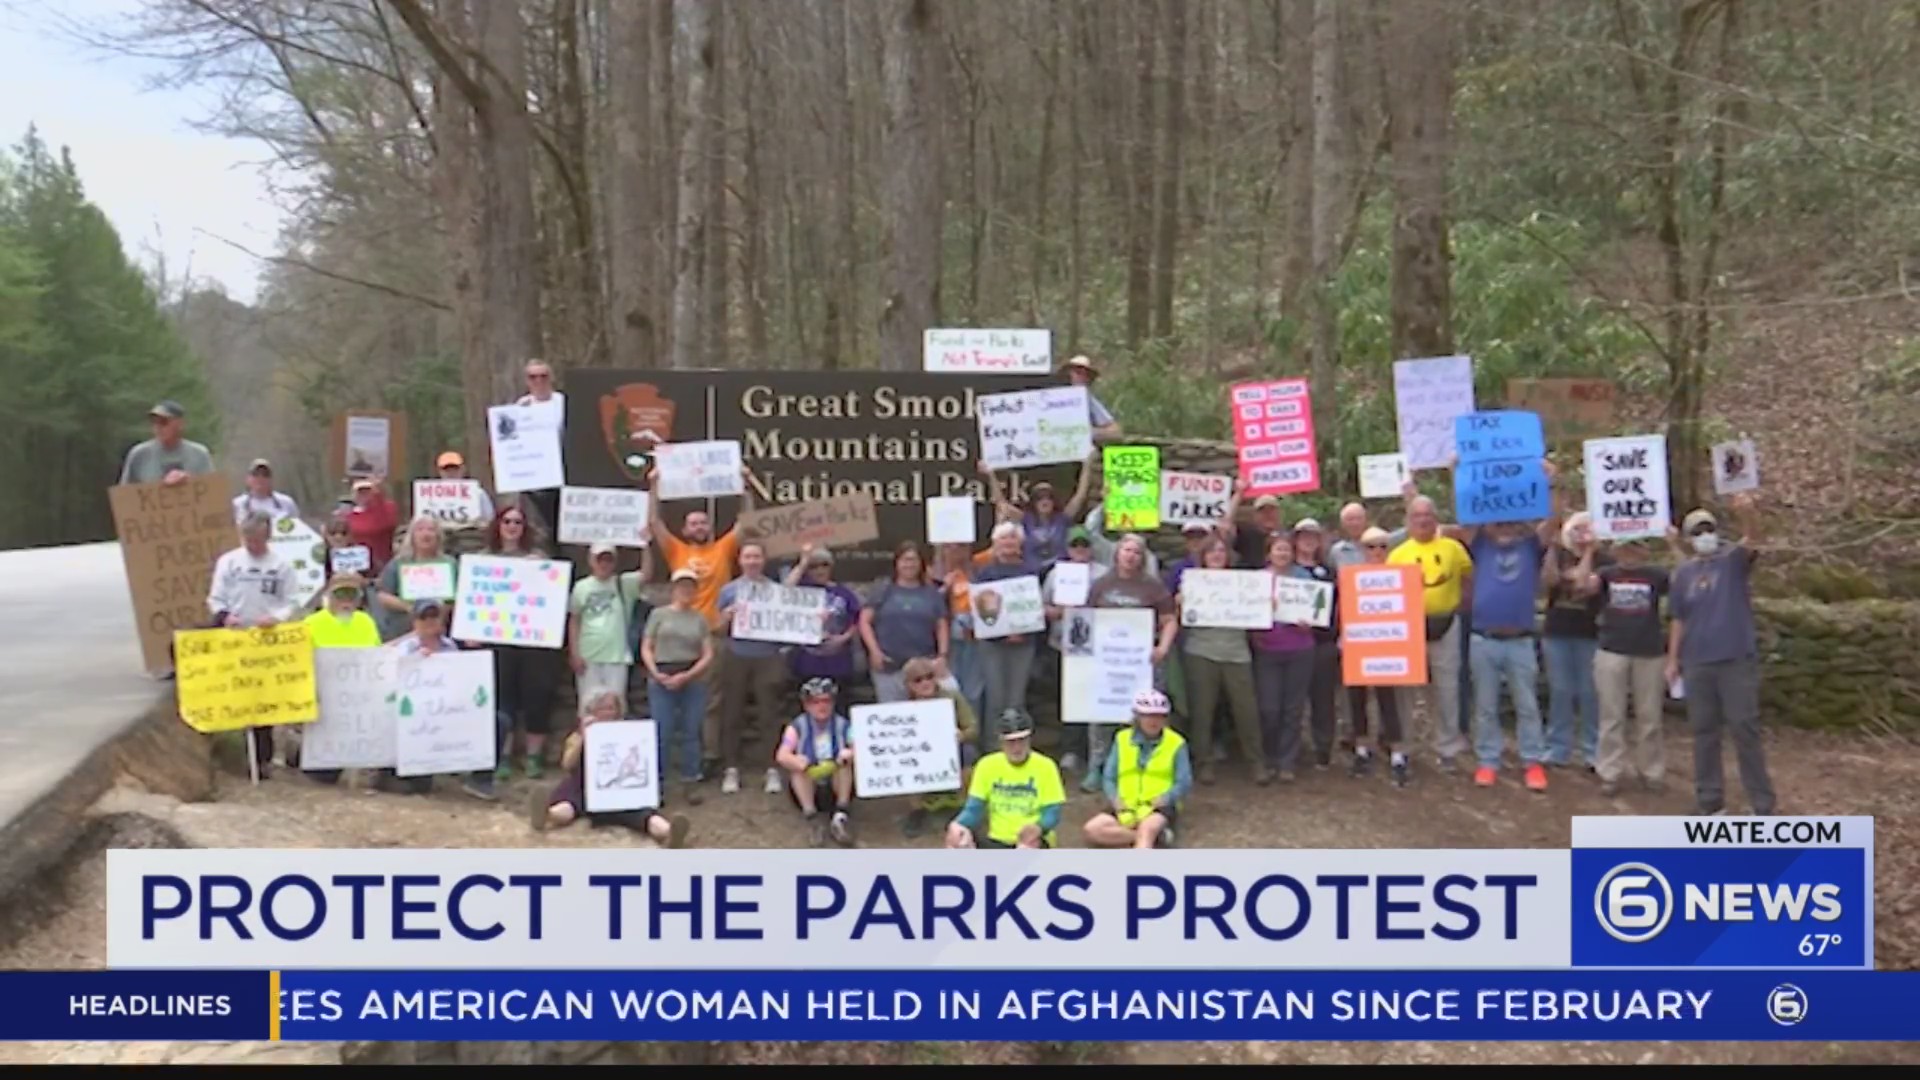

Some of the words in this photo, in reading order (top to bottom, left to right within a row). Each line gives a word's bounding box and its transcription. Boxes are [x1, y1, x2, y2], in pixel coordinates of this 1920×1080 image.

[741, 385, 859, 418] Great
[1466, 414, 1502, 430] TAX
[743, 428, 969, 462] Mountains
[1109, 451, 1153, 468] KEEP
[1601, 446, 1650, 472] SAVE
[418, 484, 471, 500] HONK
[747, 470, 924, 504] National
[938, 471, 1031, 504] Pak
[1167, 476, 1225, 493] FUND
[1601, 476, 1646, 497] OUR
[136, 481, 208, 512] KEEP
[1168, 500, 1226, 518] PARKS
[1359, 576, 1396, 590] SAVE
[1360, 600, 1393, 612] OUR
